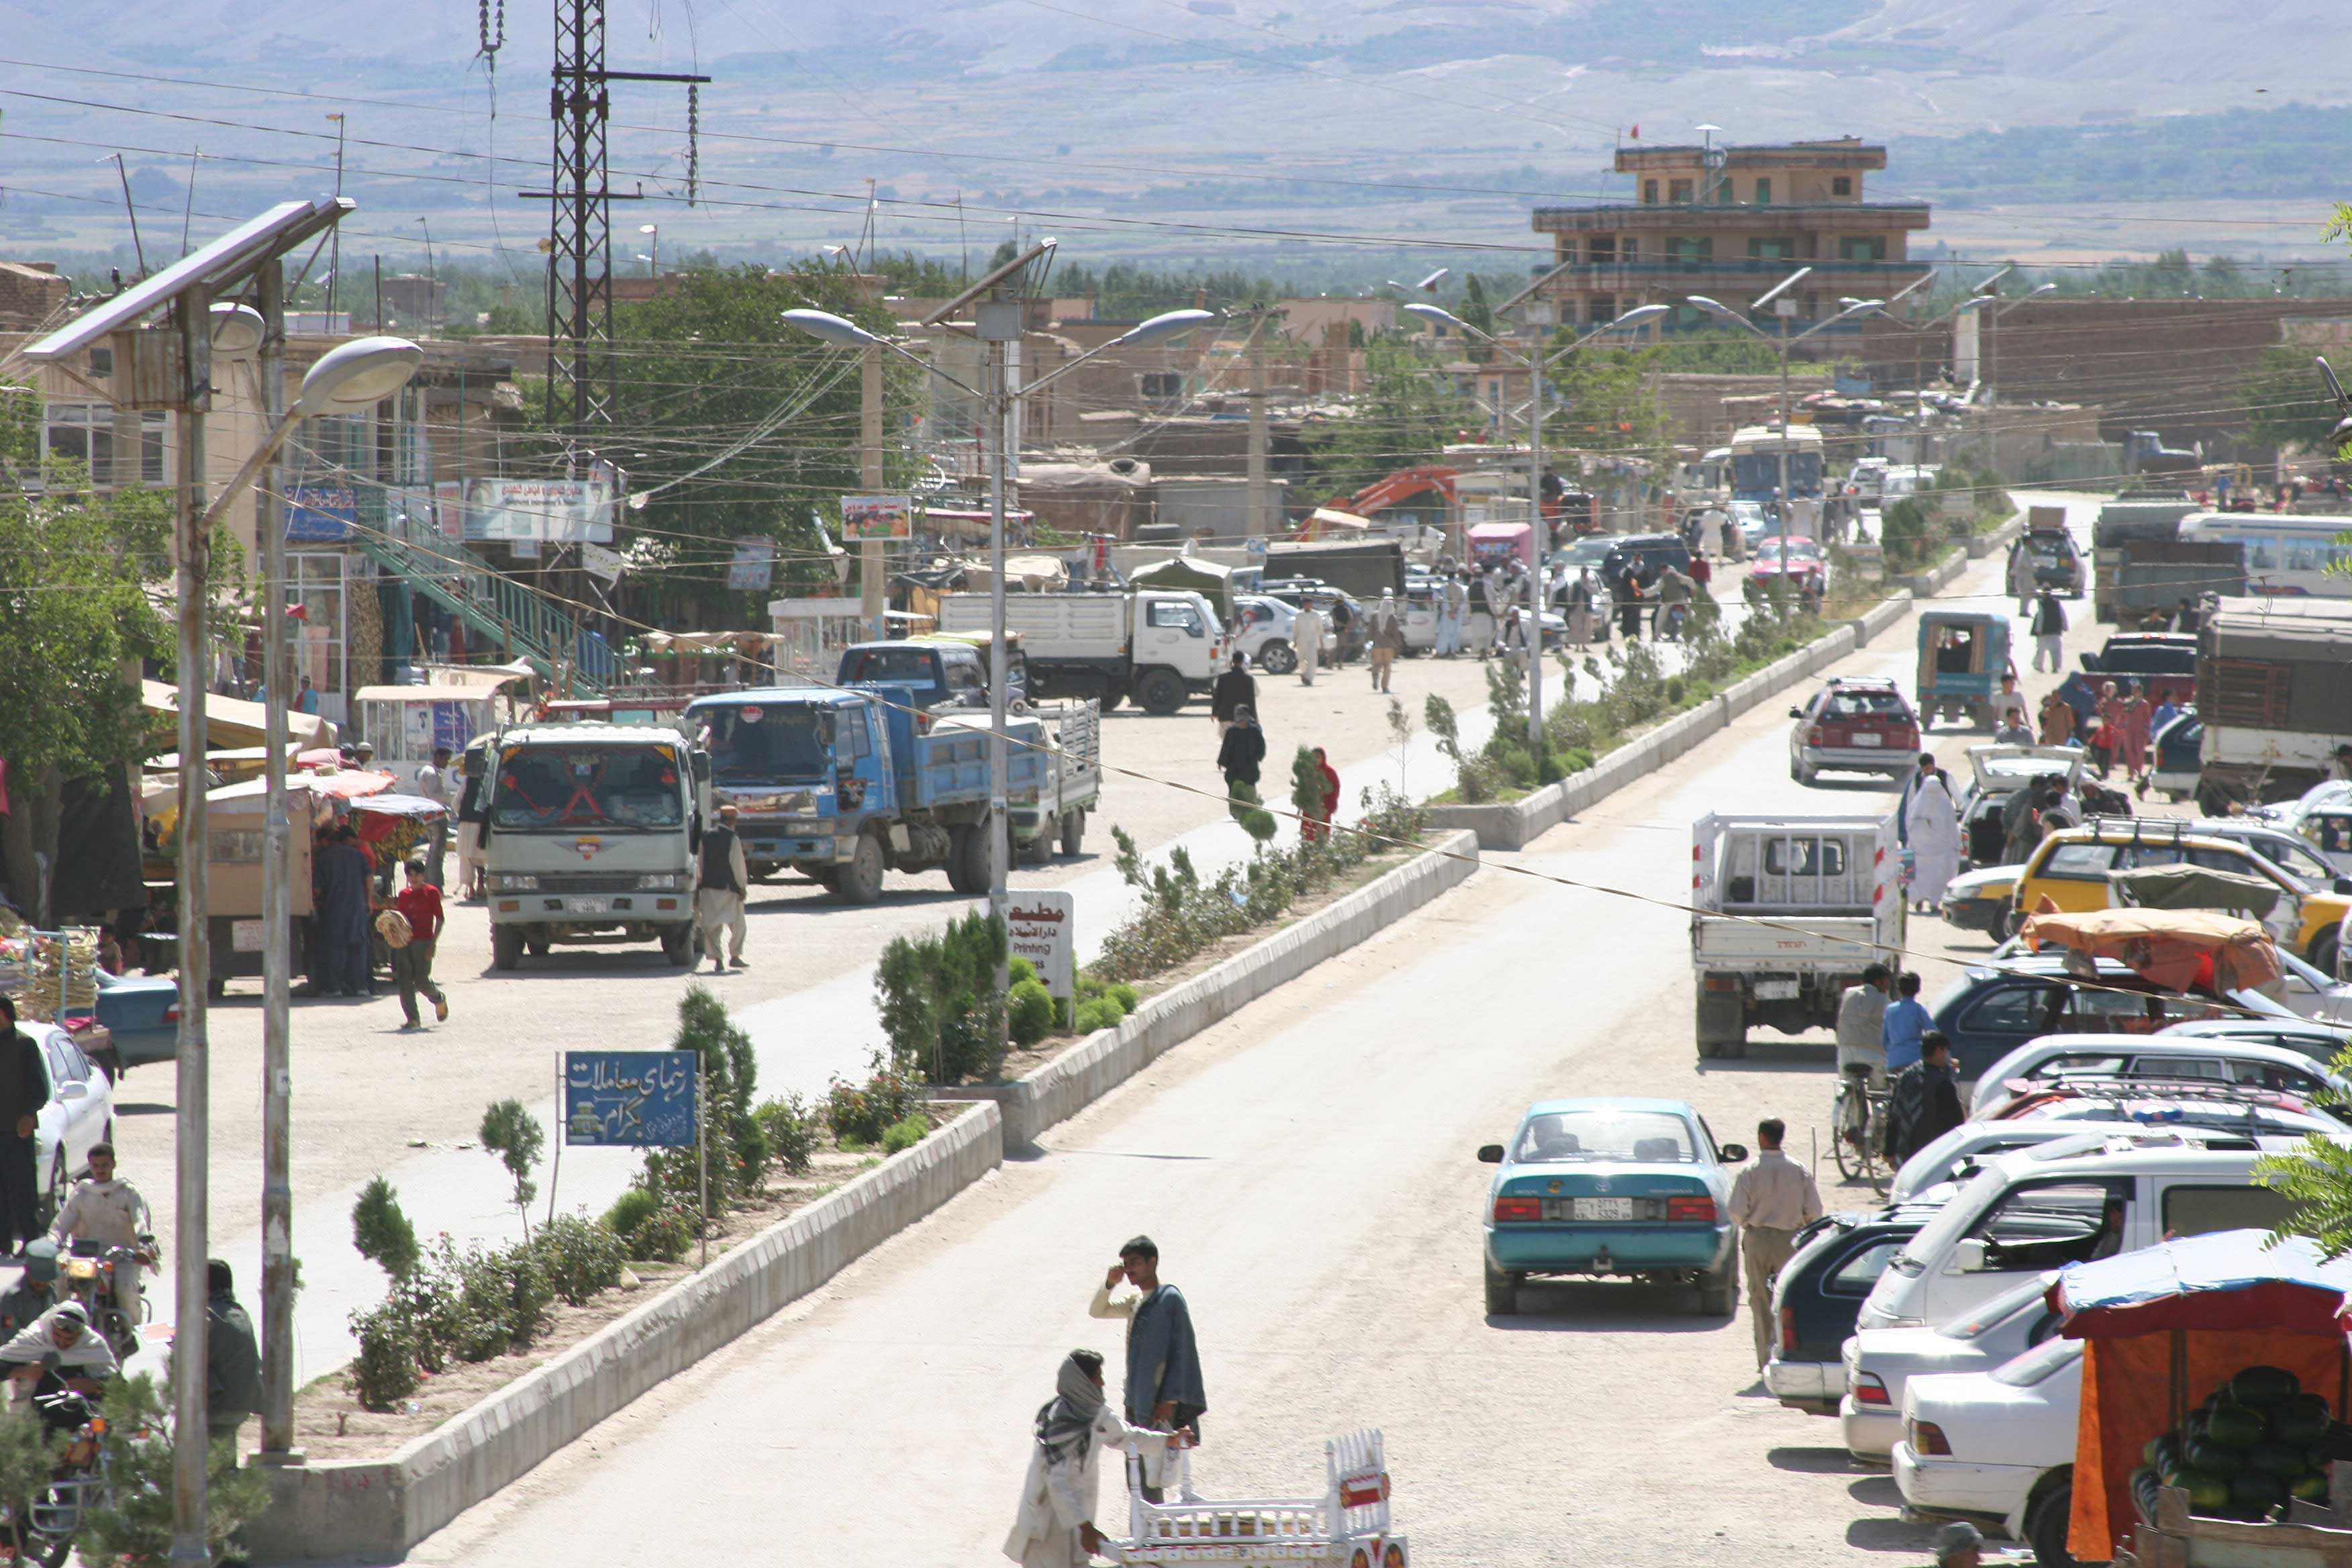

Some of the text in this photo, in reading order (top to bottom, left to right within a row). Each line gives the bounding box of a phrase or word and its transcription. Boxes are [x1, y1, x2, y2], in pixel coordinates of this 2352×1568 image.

[1010, 902, 1065, 925] مطبع
[1014, 942, 1051, 955] Printing
[569, 1060, 639, 1092] معاملات
